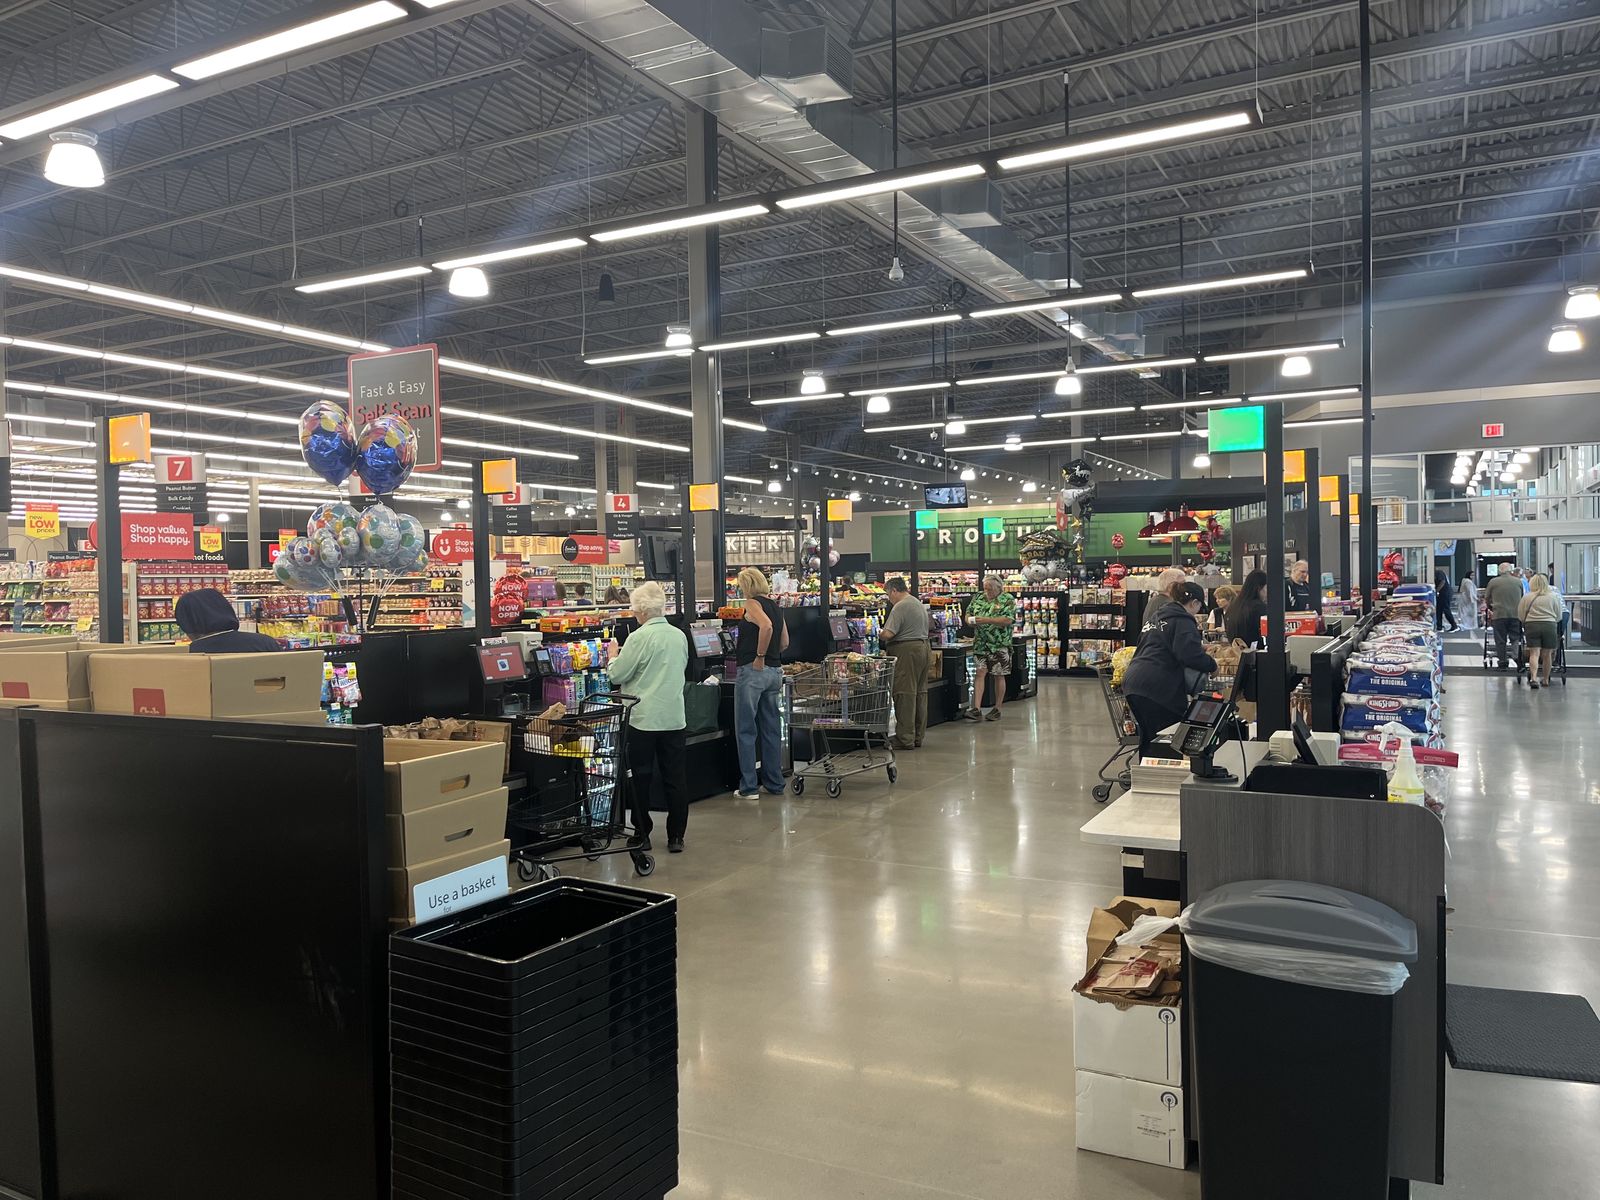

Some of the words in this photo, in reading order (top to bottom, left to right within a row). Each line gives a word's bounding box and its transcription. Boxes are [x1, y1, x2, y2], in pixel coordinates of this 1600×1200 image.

[360, 385, 383, 399] Fast
[387, 382, 395, 396] &
[399, 380, 426, 395] Easy
[355, 402, 387, 425] Self
[390, 401, 432, 420] Scan
[173, 460, 186, 477] 7
[617, 497, 626, 508] 4
[29, 520, 55, 529] LOW
[130, 524, 156, 535] Shop
[157, 524, 188, 534] value.
[130, 534, 156, 545] Shop
[157, 534, 191, 546] happy.
[205, 553, 224, 561] foods
[498, 604, 519, 612] NOW
[498, 611, 520, 619] OPEN
[1381, 678, 1408, 687] ORIGINAL
[1368, 699, 1400, 708] KINGSFORD
[1376, 714, 1402, 722] ORIGINAL
[428, 893, 450, 909] Use
[452, 890, 459, 900] a
[461, 875, 496, 897] basket
[443, 905, 452, 914] for
